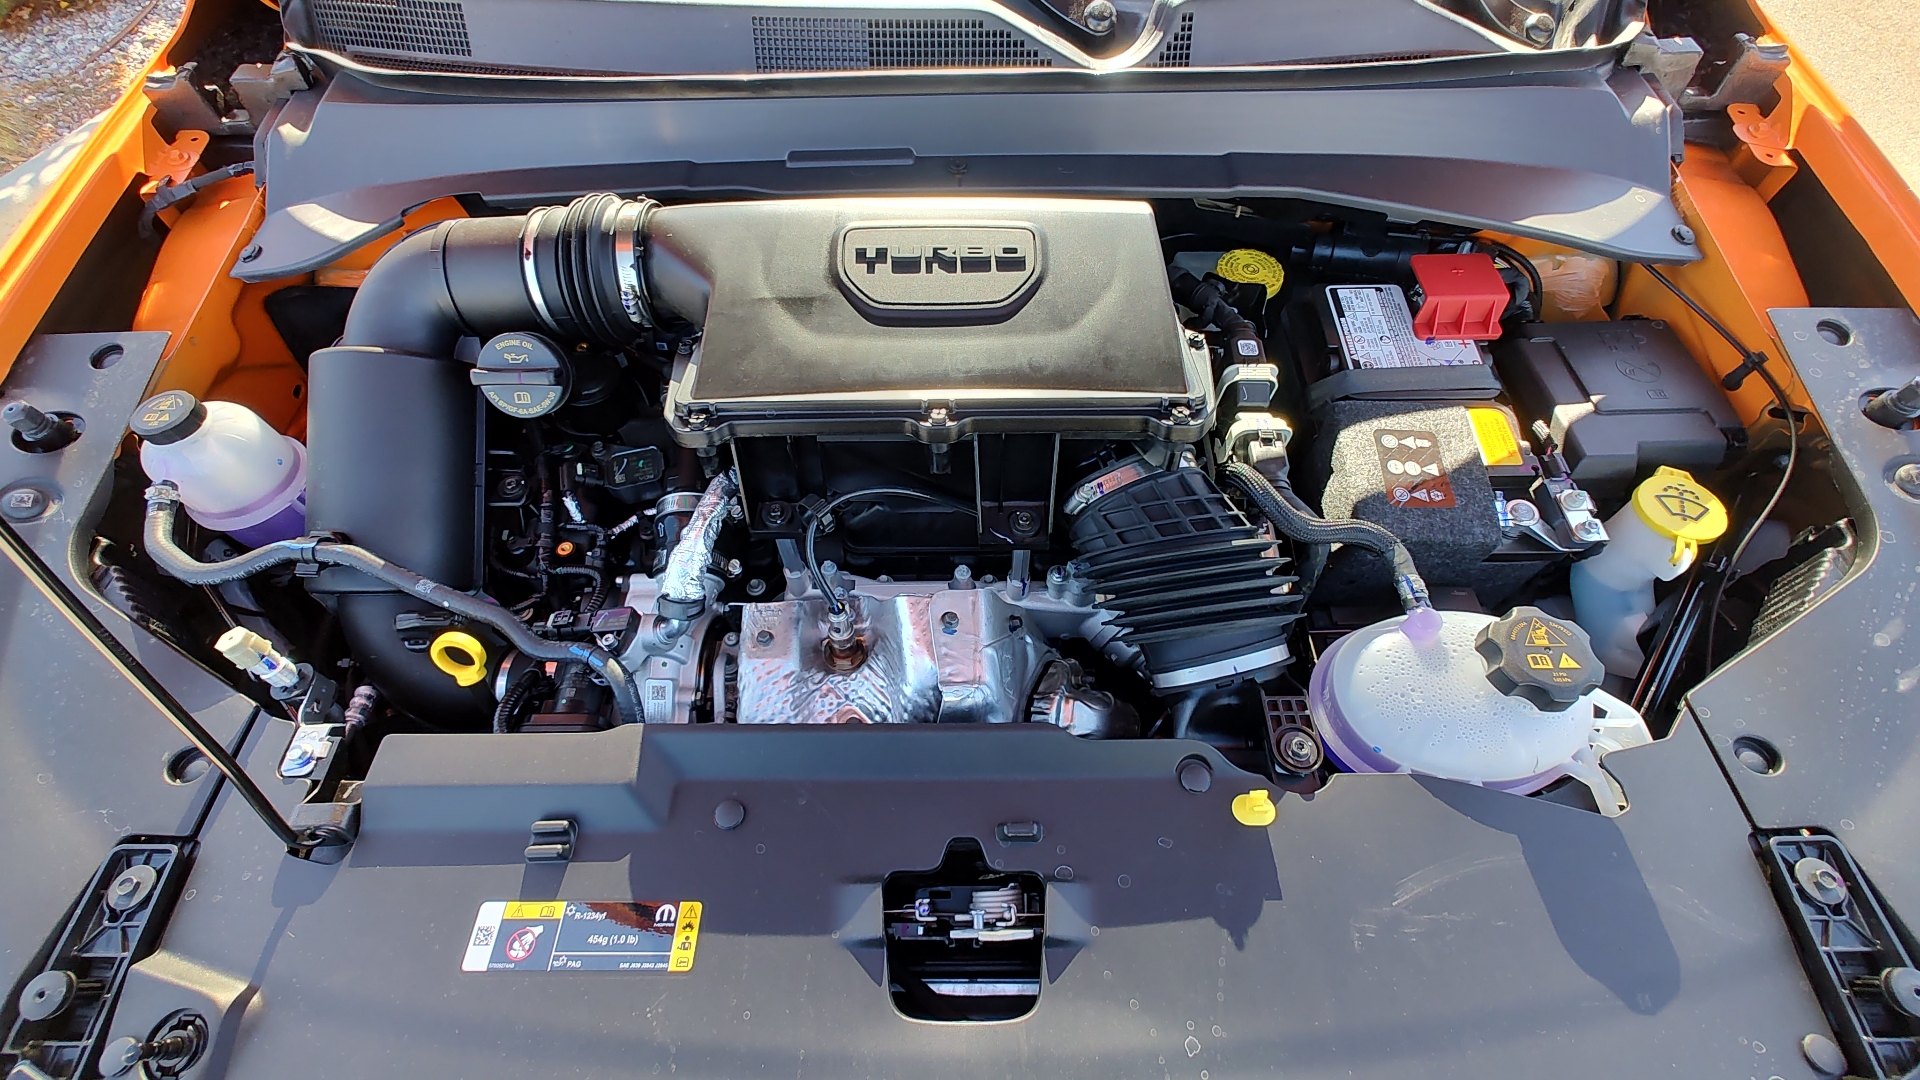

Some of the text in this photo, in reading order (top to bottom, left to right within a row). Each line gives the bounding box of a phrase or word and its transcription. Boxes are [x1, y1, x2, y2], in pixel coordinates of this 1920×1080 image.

[855, 245, 1027, 275] TURBO
[494, 339, 534, 351] ENGINE OIL
[488, 391, 500, 402] API
[574, 911, 607, 922] R-1234yf
[586, 934, 639, 946] 454g (1.0 lb)
[566, 960, 582, 969] PAG
